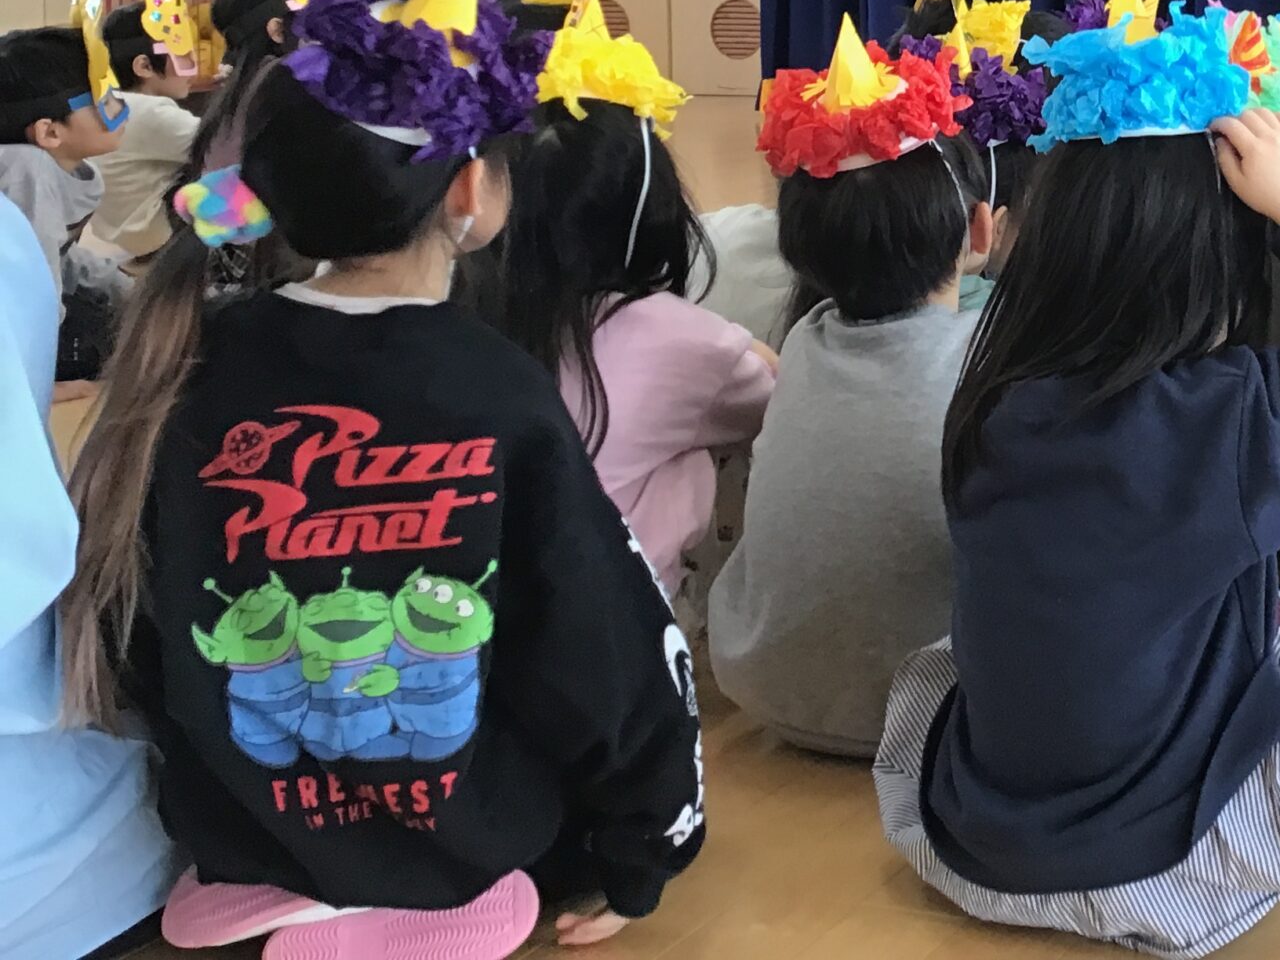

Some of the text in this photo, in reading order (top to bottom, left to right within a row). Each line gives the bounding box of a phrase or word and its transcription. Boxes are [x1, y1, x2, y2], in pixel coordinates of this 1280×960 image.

[273, 403, 498, 488] Pizza
[202, 478, 498, 565] Planet
[333, 800, 374, 826] THE
